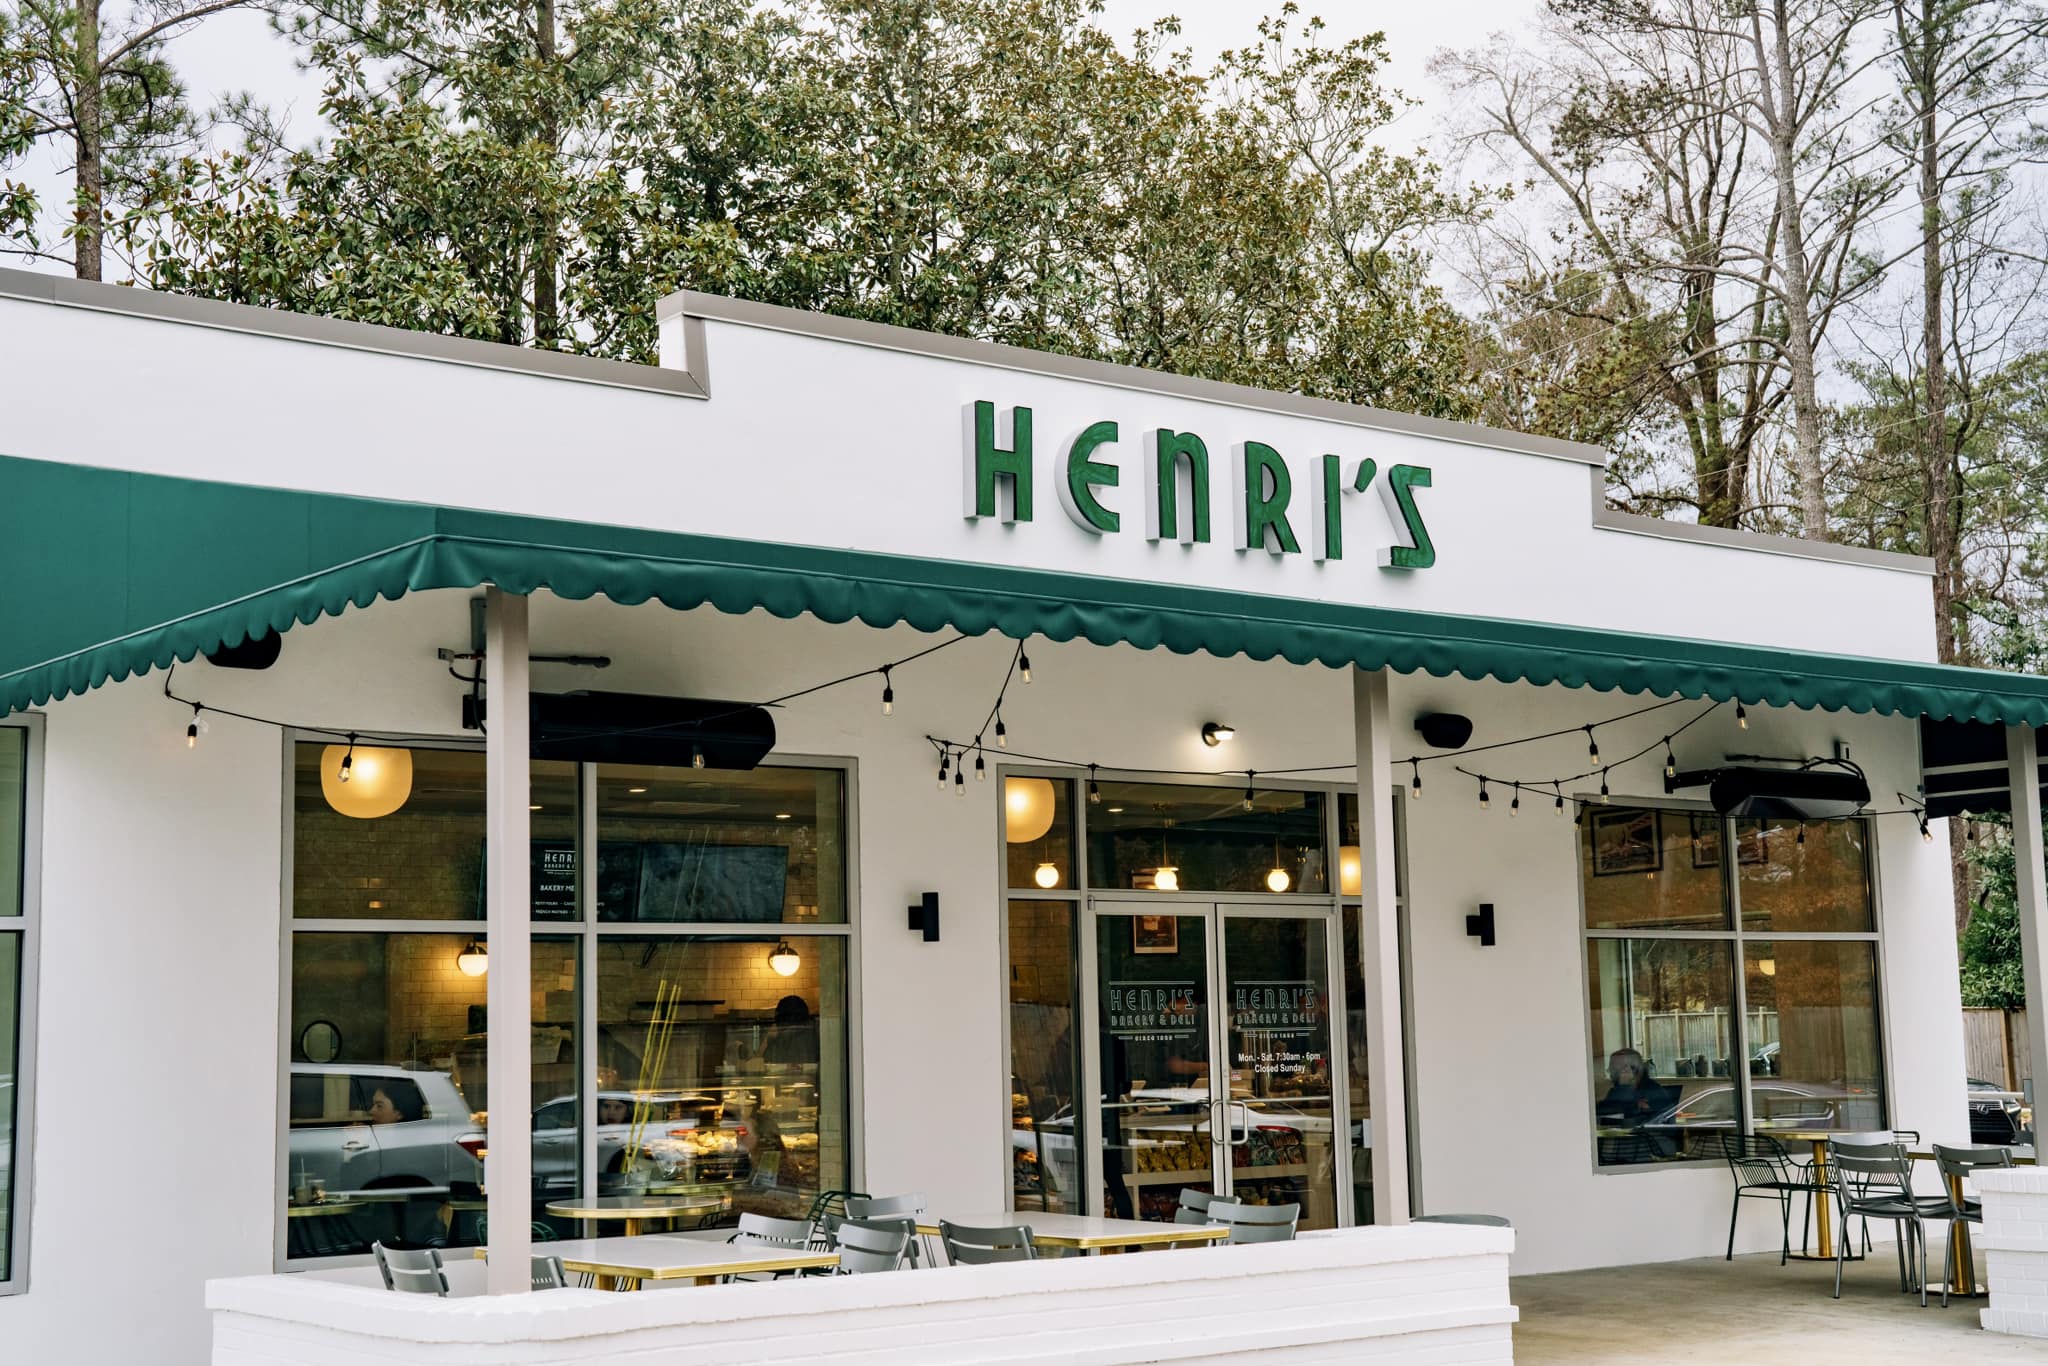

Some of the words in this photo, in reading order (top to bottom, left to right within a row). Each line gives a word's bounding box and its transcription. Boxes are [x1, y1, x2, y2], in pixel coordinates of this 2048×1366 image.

[963, 400, 1436, 569] HENRI'S
[544, 853, 576, 863] HENRI
[540, 884, 565, 892] BAKERY
[565, 884, 575, 892] ME
[1111, 989, 1194, 1011] HENRI'S
[1236, 988, 1315, 1010] HENRI'S
[1111, 1014, 1155, 1026] BAKERY
[1159, 1014, 1167, 1025] &
[1170, 1014, 1195, 1025] DELI
[1282, 1012, 1289, 1024] &
[1292, 1012, 1315, 1024] DELI
[1275, 1052, 1300, 1061] 7:30am
[1305, 1051, 1321, 1062] 6pm
[1254, 1064, 1278, 1073] Closed
[1280, 1063, 1306, 1074] Sunday
